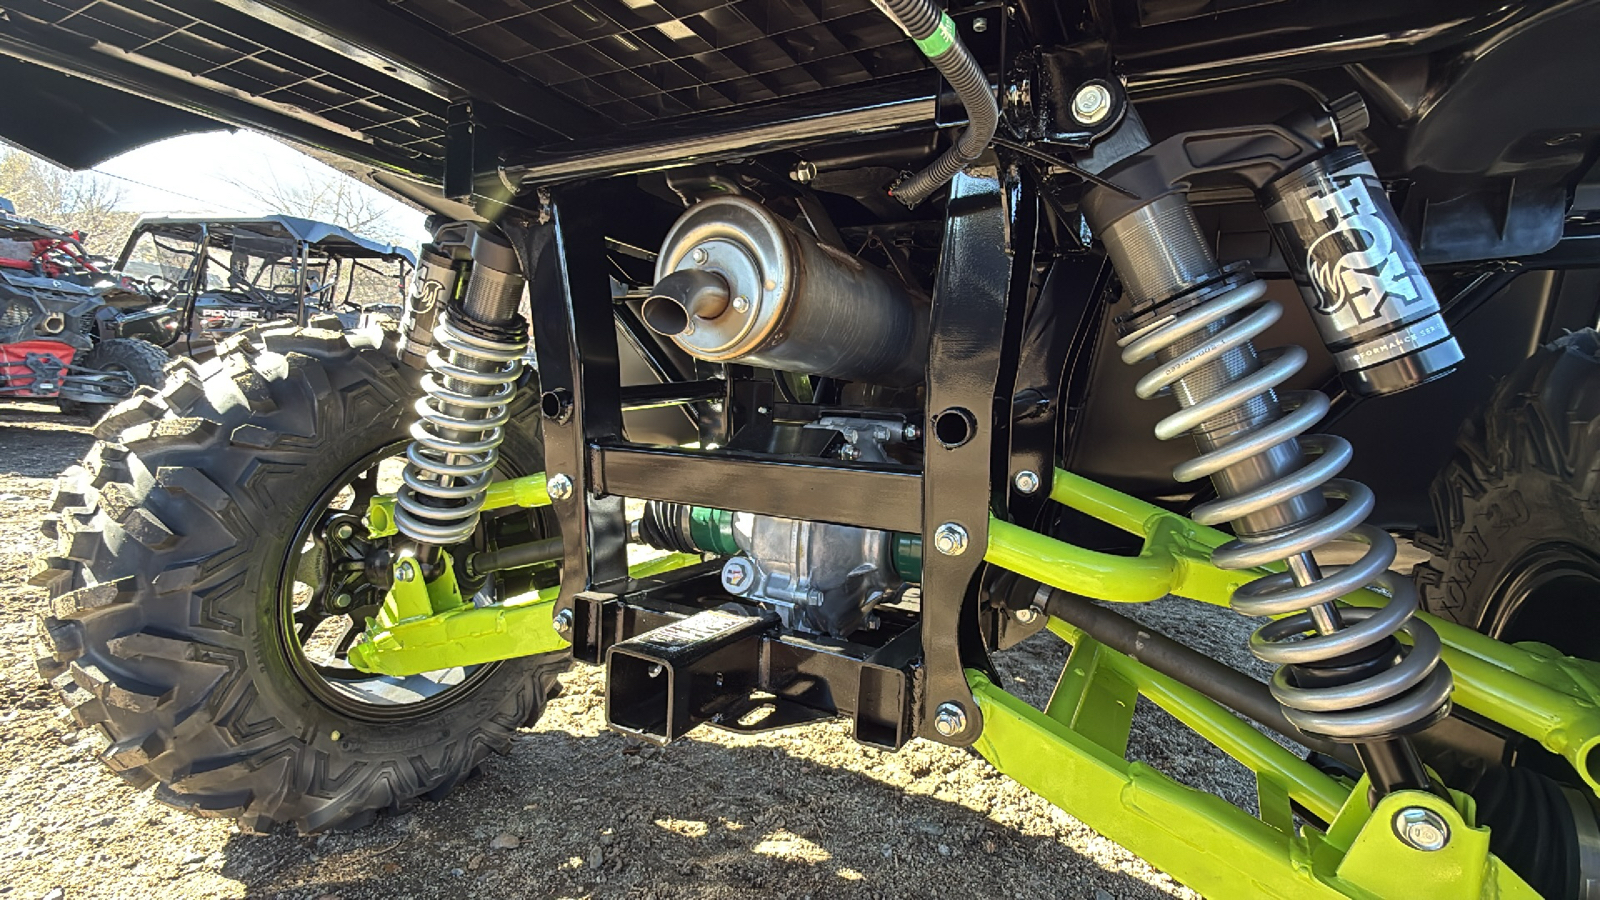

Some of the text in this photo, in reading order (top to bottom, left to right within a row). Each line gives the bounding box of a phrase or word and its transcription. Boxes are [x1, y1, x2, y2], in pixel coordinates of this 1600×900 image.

[1305, 176, 1419, 320] FOX
[202, 308, 259, 319] PIONEER
[1352, 331, 1419, 362] FORMANCE
